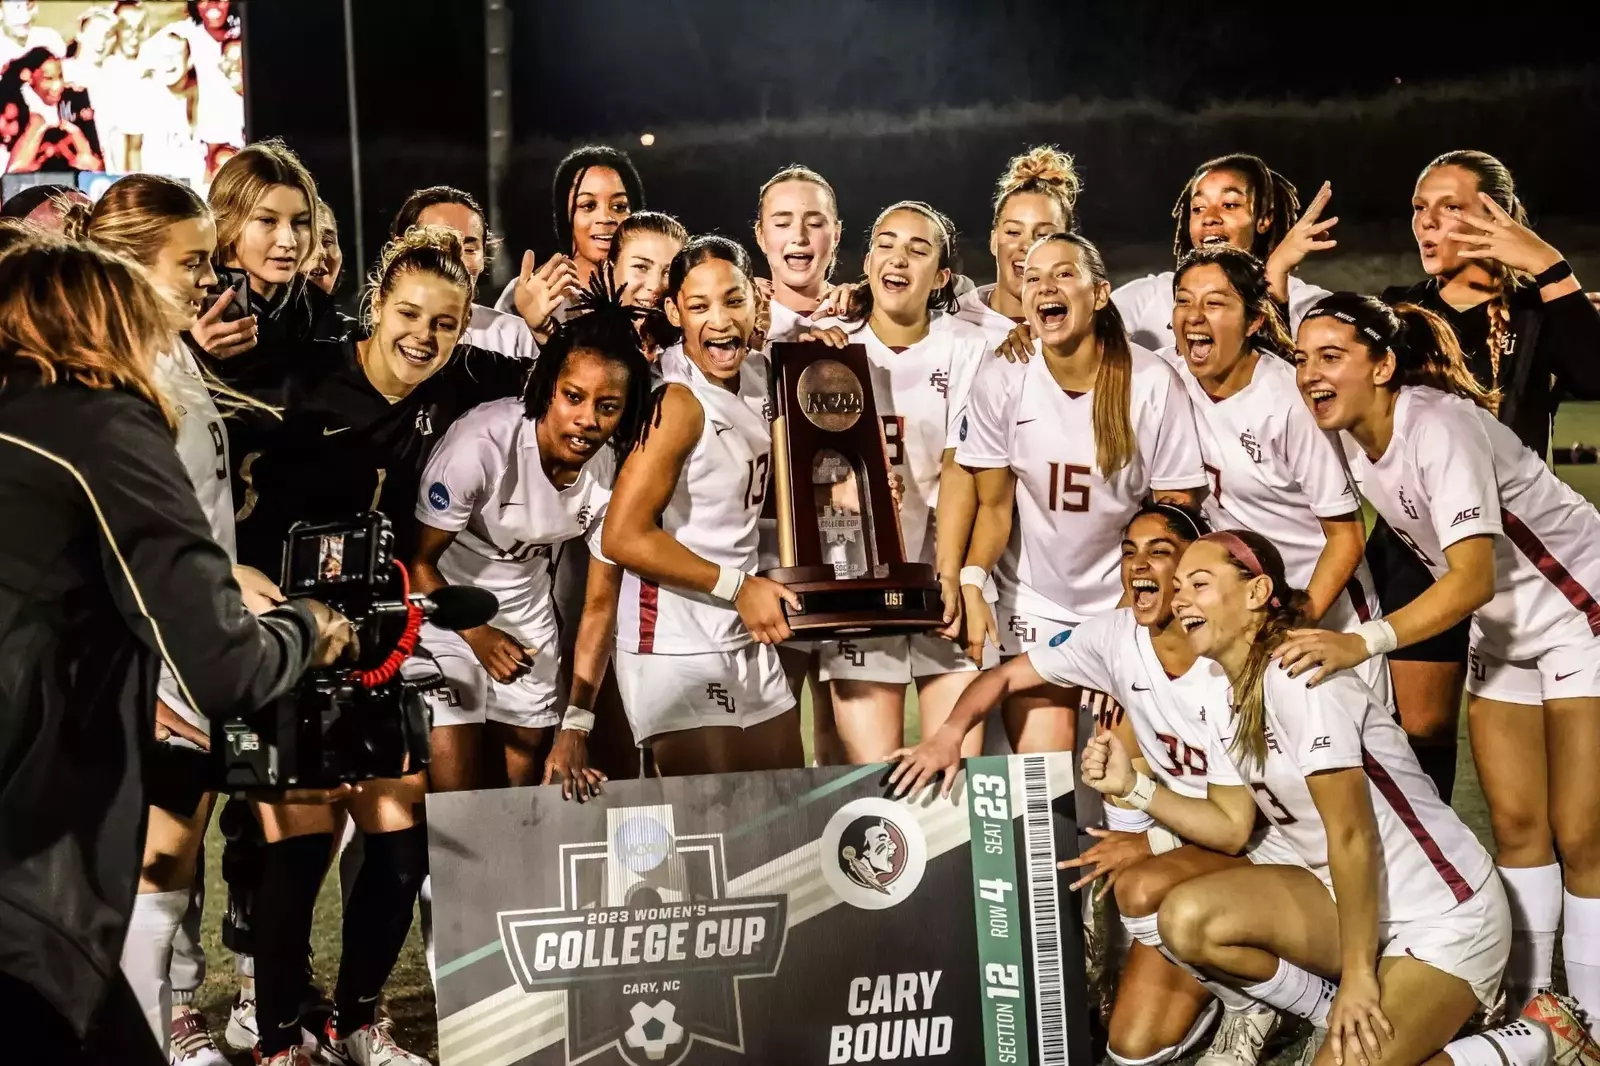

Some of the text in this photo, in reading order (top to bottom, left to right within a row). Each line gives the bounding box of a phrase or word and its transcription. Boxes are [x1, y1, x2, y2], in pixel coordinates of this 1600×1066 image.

[1334, 311, 1357, 323] NIKE
[1363, 326, 1382, 341] NIKE
[1047, 460, 1092, 513] 15
[1451, 506, 1481, 525] ACC
[884, 592, 904, 606] LIST
[1008, 615, 1037, 643] FSU
[706, 682, 736, 713] FSU
[587, 904, 707, 925] 2023 WOMEN'S
[972, 773, 1020, 1063] SECTION 12 ROW 4 SEAT 23
[533, 915, 766, 972] COLLEGE CUP
[622, 980, 681, 996] CARY, NC
[847, 970, 943, 1016] CARY
[828, 1015, 954, 1065] BOUND
